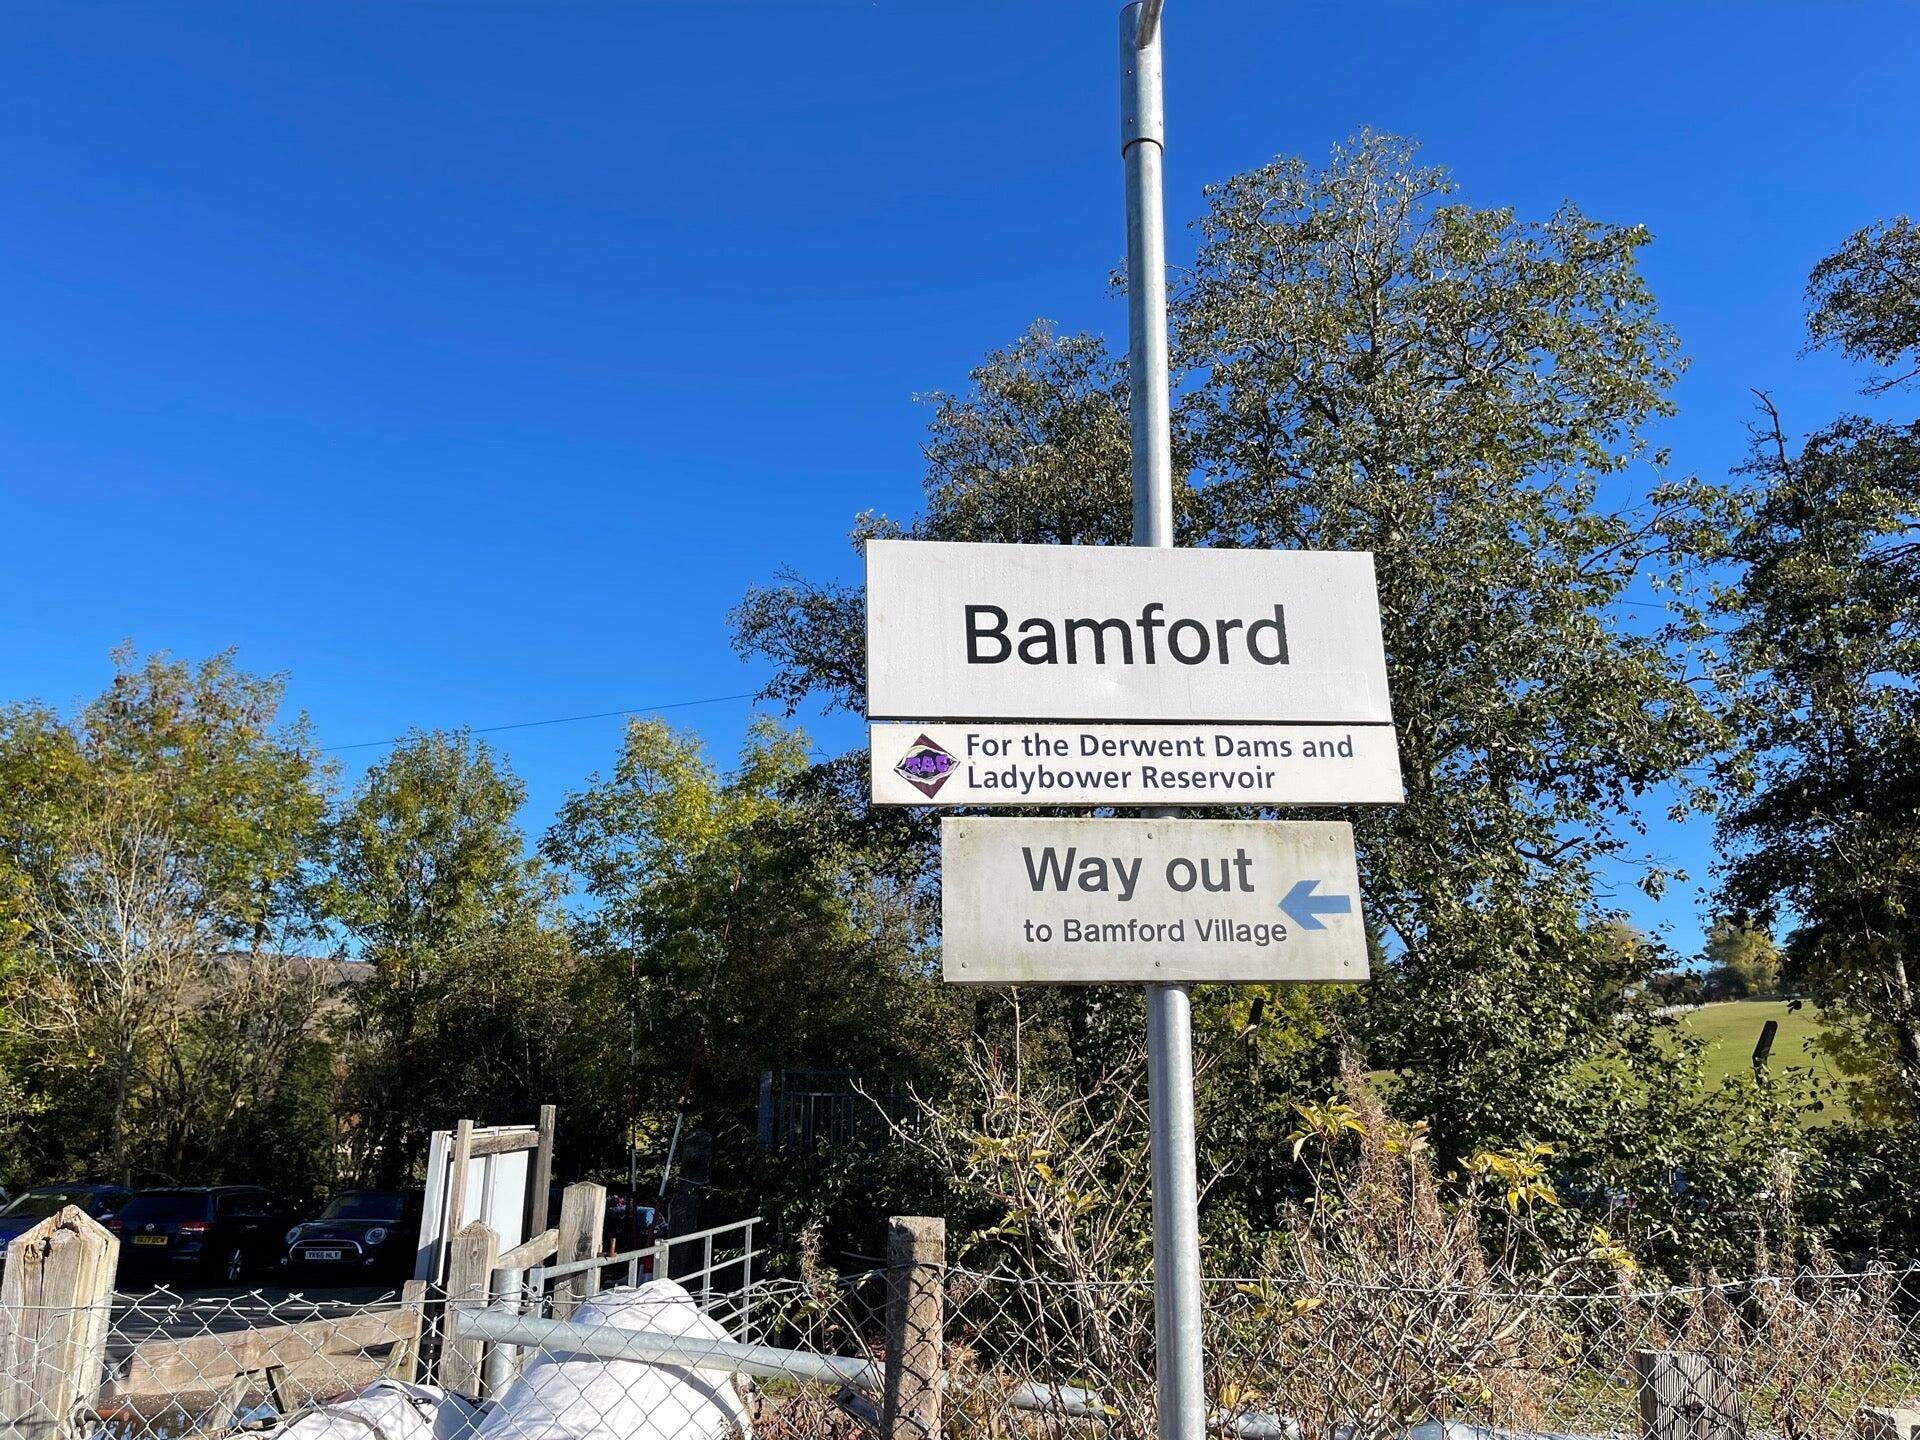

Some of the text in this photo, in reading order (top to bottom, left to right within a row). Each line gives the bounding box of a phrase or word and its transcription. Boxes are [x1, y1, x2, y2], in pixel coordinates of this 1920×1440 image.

[965, 602, 1290, 666] Bamford
[967, 733, 1353, 758] For the Derwent Dams and
[968, 764, 1275, 795] Ladybower Reservoir
[1022, 846, 1255, 902] Way out
[1024, 918, 1288, 947] to Bamford Village
